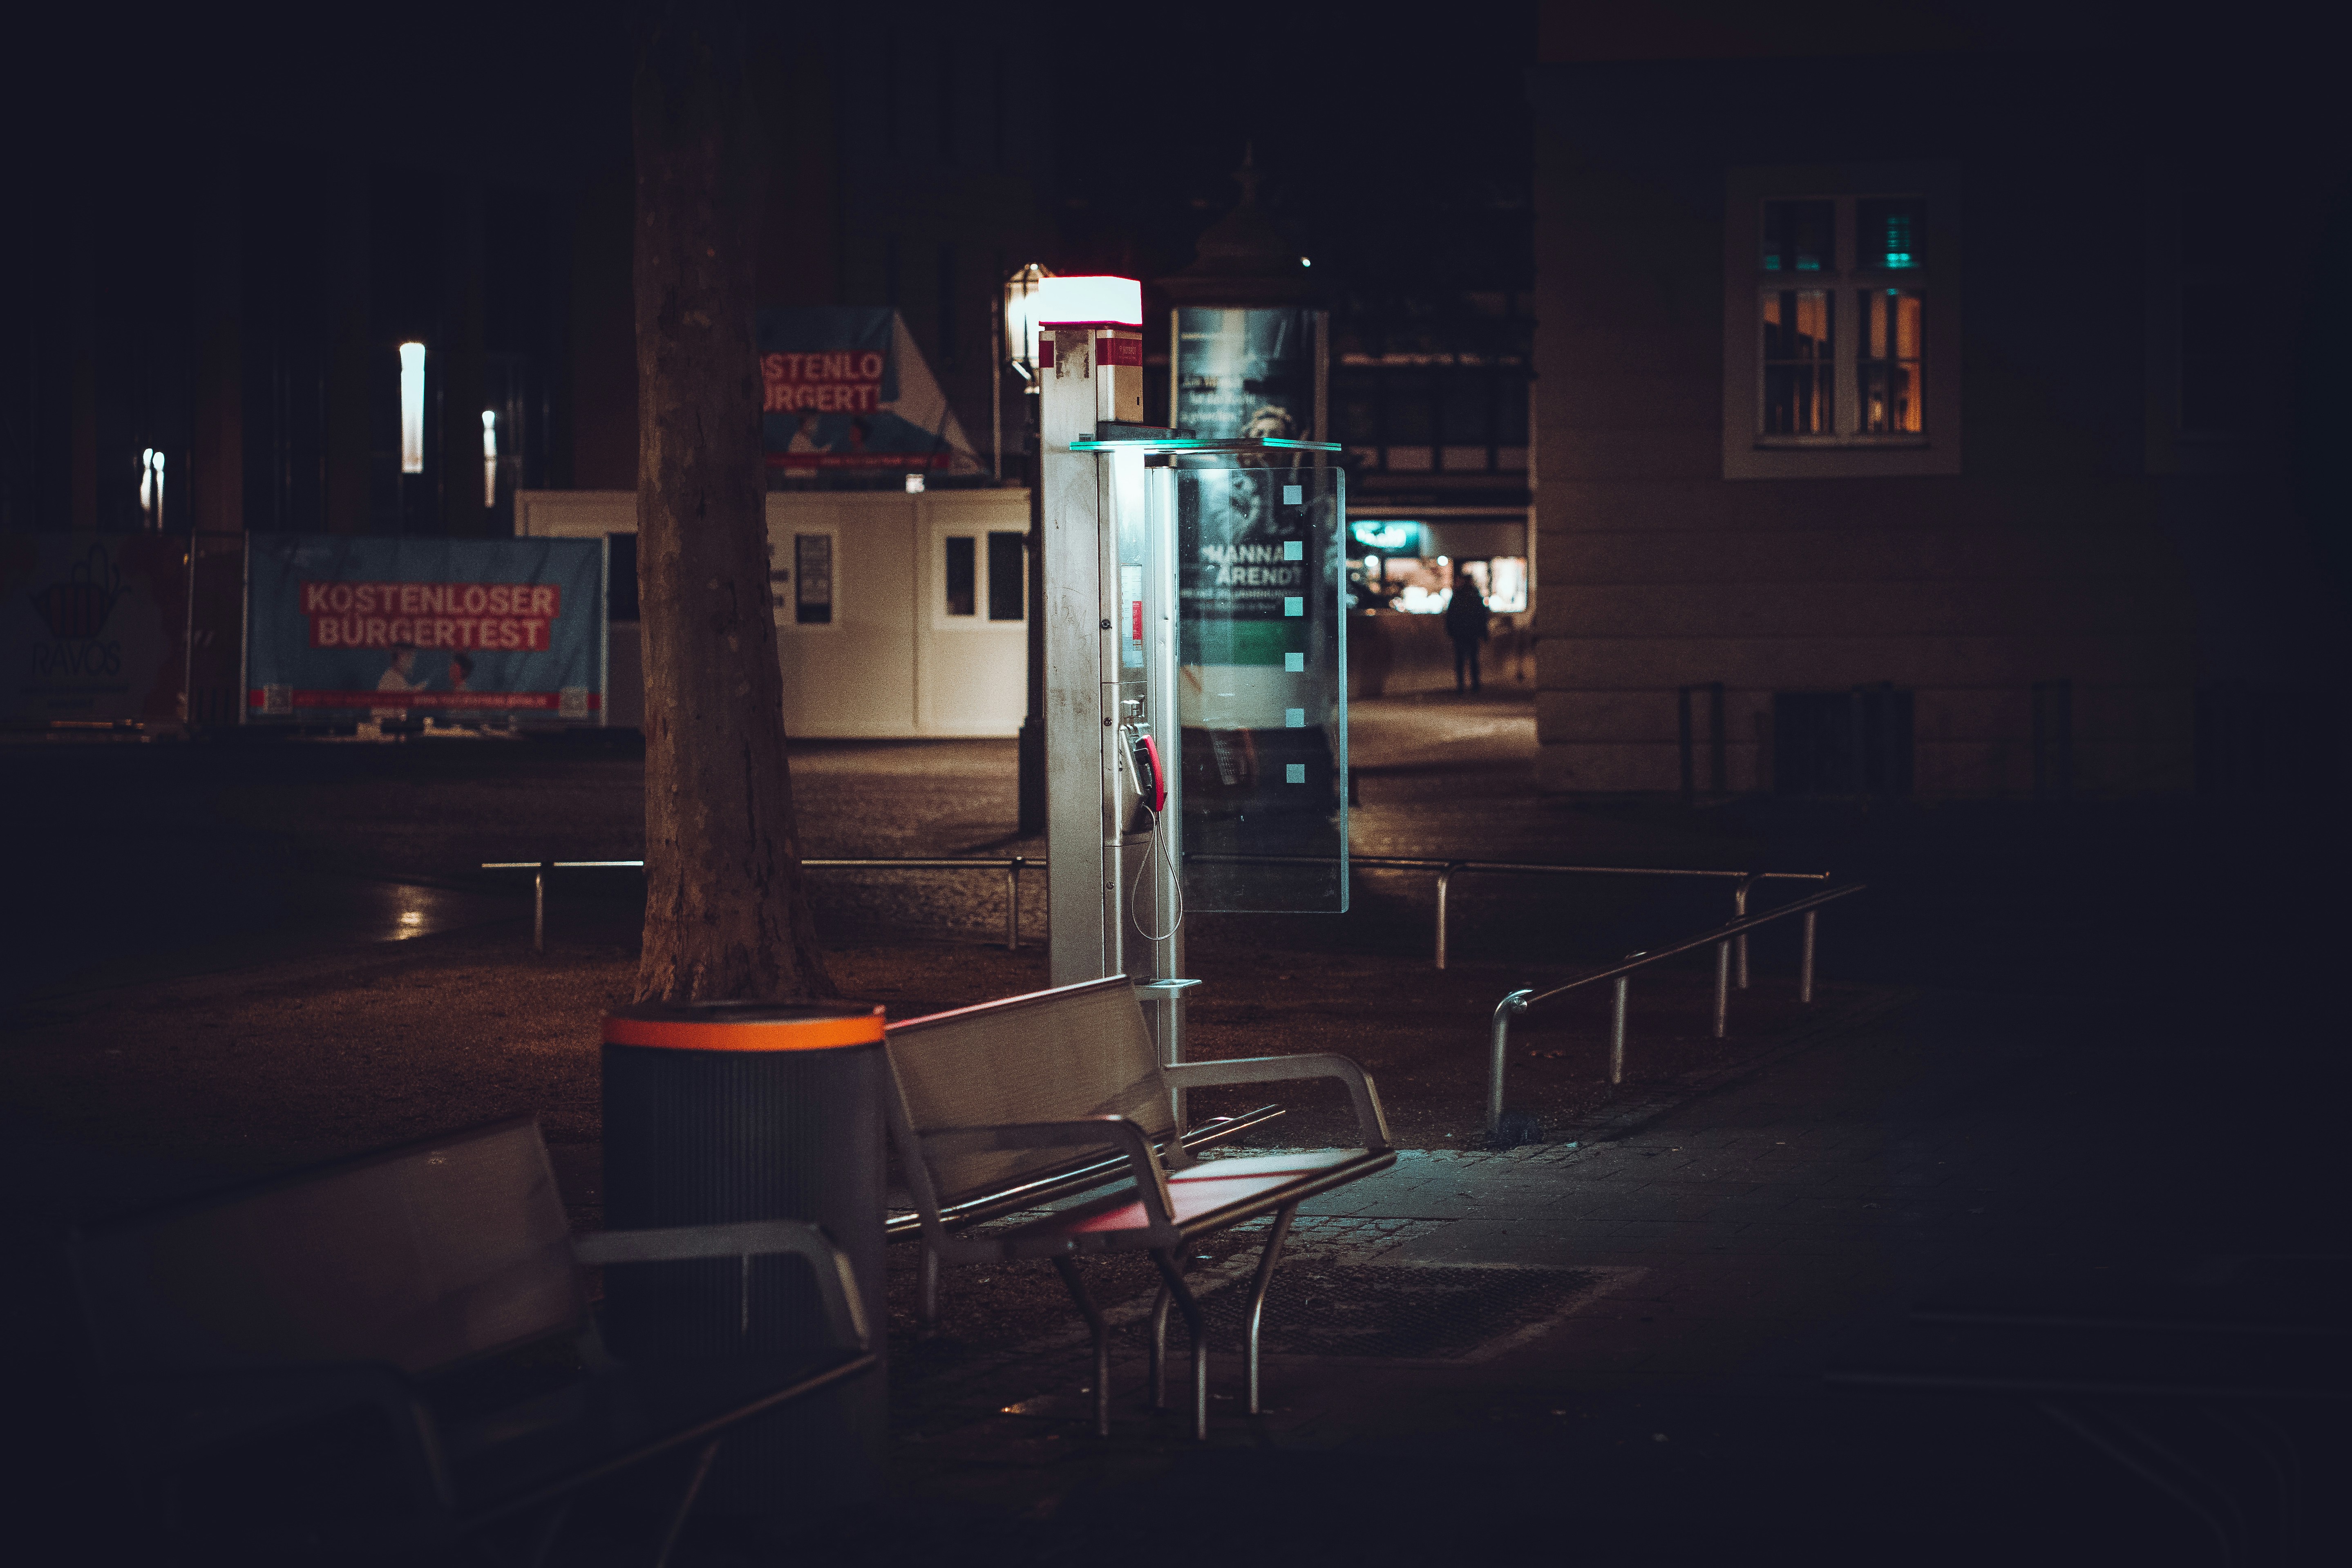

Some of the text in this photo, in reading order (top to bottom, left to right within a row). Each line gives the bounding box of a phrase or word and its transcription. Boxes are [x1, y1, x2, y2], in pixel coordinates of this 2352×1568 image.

[759, 352, 883, 380] STENLO
[1207, 544, 1286, 564] HANNA
[1215, 566, 1301, 586] ARENDT
[307, 583, 552, 614] KOSTENLOSER
[317, 613, 543, 647] BÜRGERTEST
[32, 640, 121, 677] RAVOS
